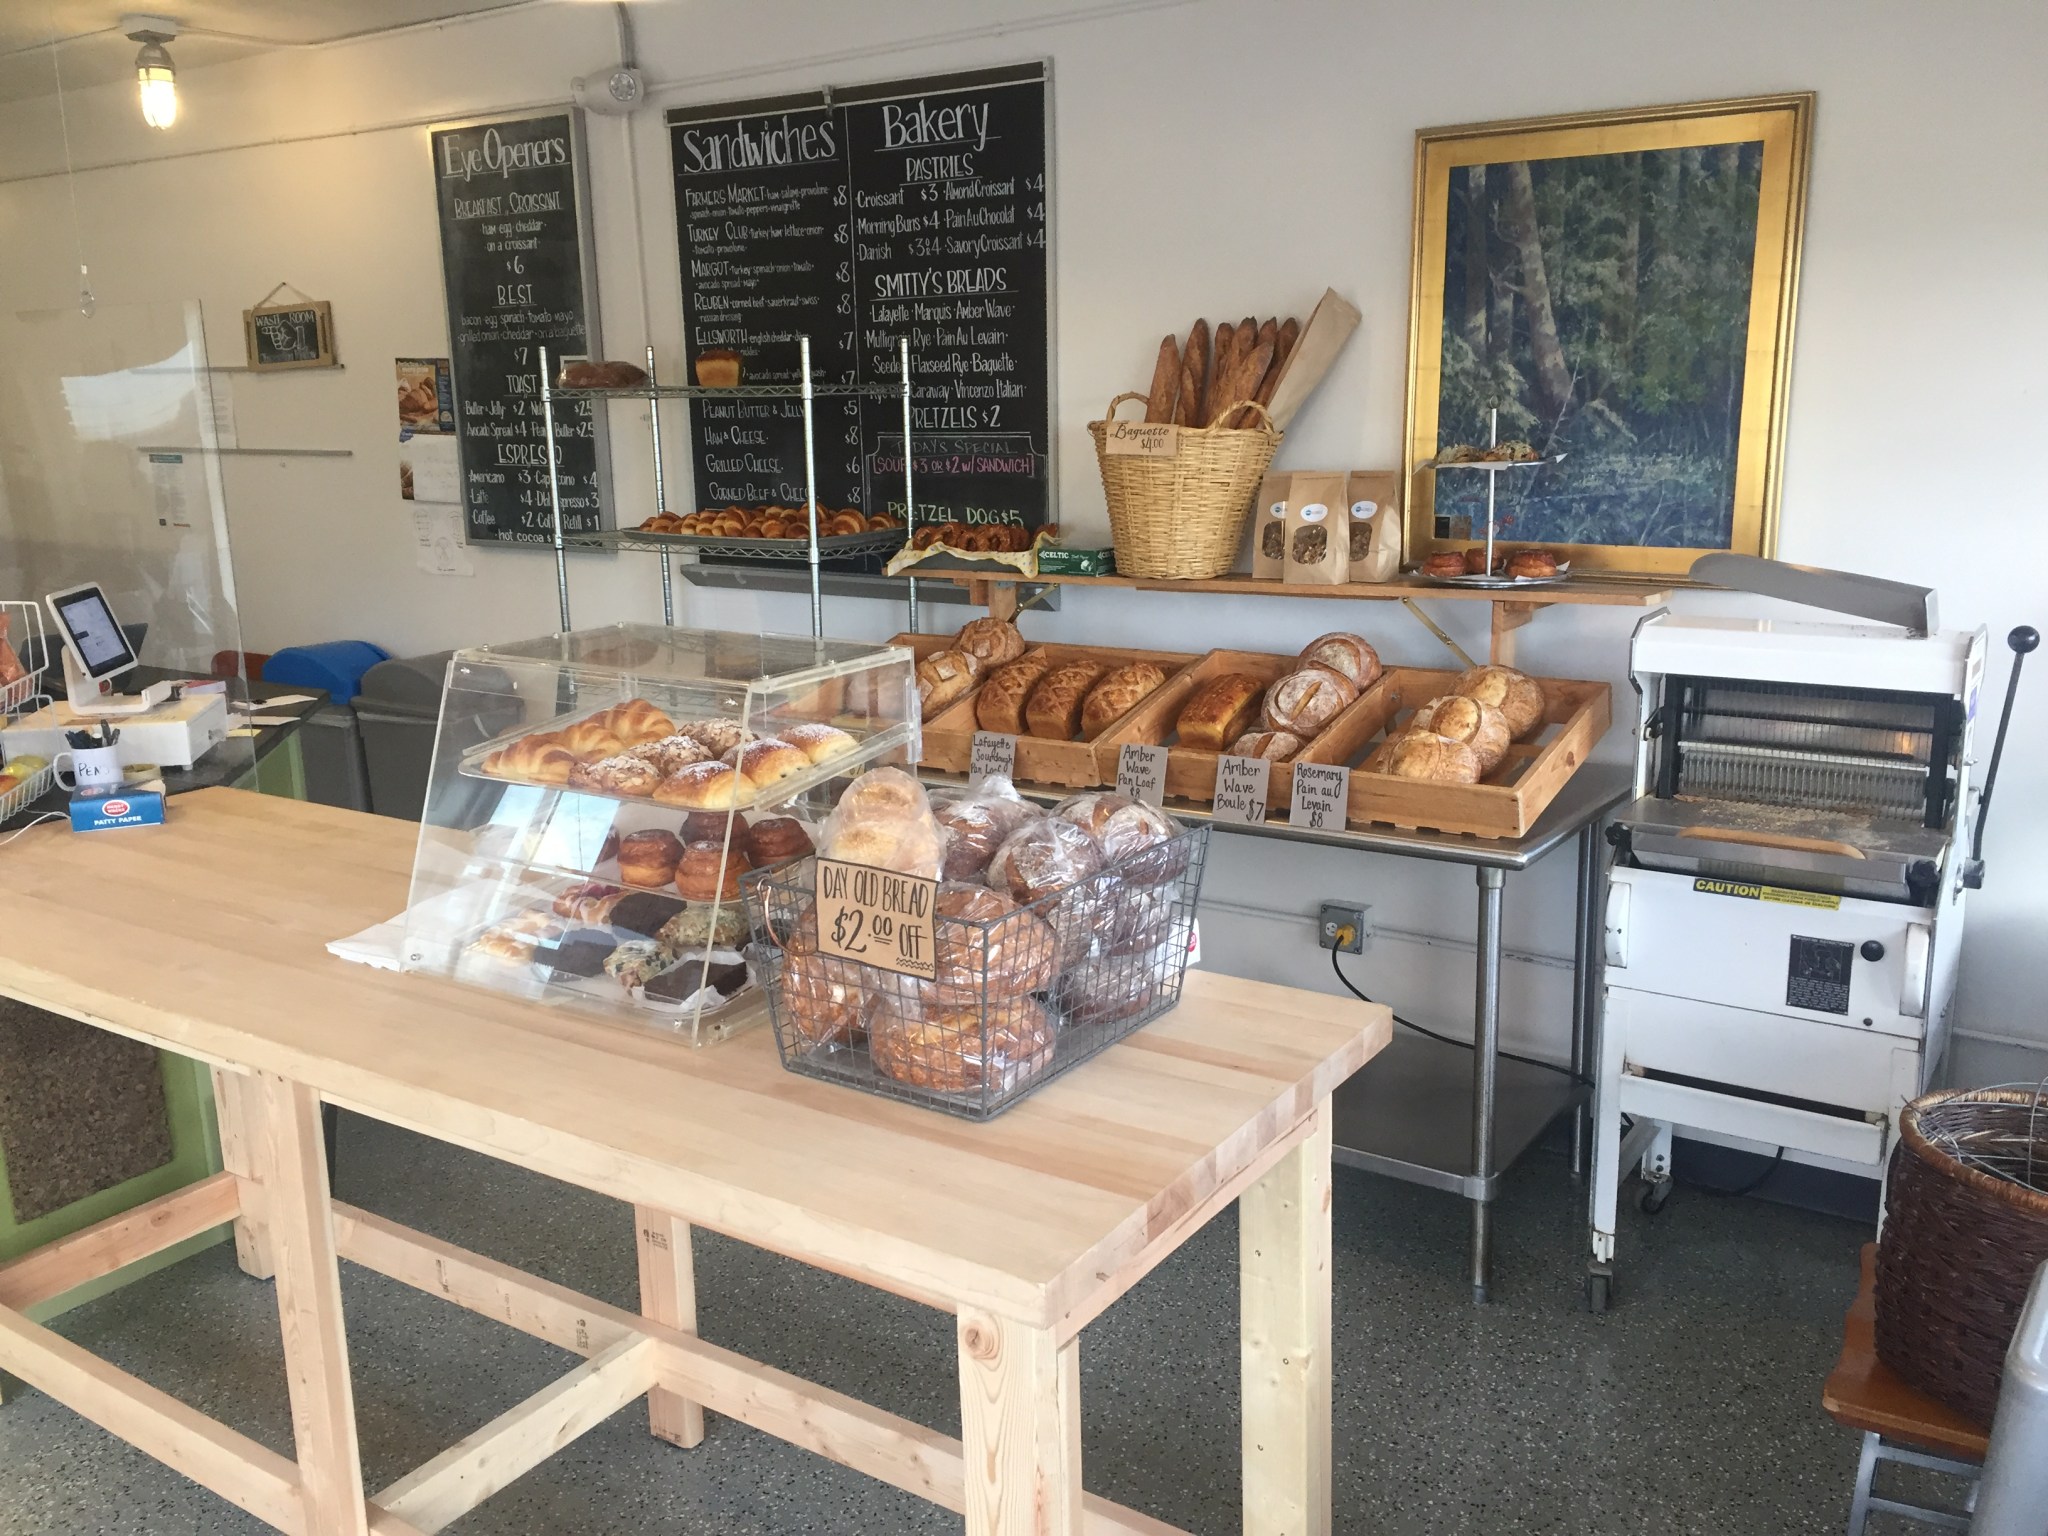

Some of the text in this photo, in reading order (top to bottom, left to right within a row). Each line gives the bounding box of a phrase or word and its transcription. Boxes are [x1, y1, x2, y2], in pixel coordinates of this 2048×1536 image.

[882, 99, 989, 152] Bakery
[683, 114, 836, 173] Sandwiches
[442, 128, 566, 182] Eye Openers
[905, 152, 974, 181] PASTRIES
[685, 187, 726, 207] FARMERS
[727, 182, 765, 203] MARKET
[974, 176, 1015, 198] Croissant
[454, 191, 560, 219] BREAKFAST CROISSANT
[857, 188, 904, 208] Croissant
[979, 204, 1015, 225] Chocolat
[687, 223, 719, 243] TURKEY
[725, 221, 749, 240] CLUB
[858, 216, 896, 238] Morning
[896, 214, 921, 233] Buns
[858, 241, 892, 262] Danish
[980, 231, 1023, 254] Croissant
[691, 259, 729, 278] MARGOT
[874, 267, 1007, 298] SMITTY'S BREADS
[694, 292, 729, 311] REUBEN
[871, 298, 1012, 326] Lafayette Marquis Amber Wave
[695, 327, 749, 346] ELLSWORTH
[912, 325, 1005, 352] Rye Pain Au Levain
[873, 352, 1014, 377] Seede Flaxseed Rye Baguette
[506, 374, 538, 394] TOAST
[953, 379, 995, 399] Vincenzo
[996, 378, 1024, 399] Italian
[703, 399, 735, 419] PEANUT
[736, 399, 770, 418] BUTTER
[704, 426, 723, 446] HAM
[1112, 422, 1170, 440] Baguette
[498, 443, 562, 465] ESPRESO
[890, 439, 1018, 455] TDAY'S SPECIAL
[1141, 437, 1164, 452] $4.00
[705, 453, 744, 473] GRILLED
[931, 460, 943, 471] OR
[780, 482, 815, 502] CHEE
[472, 509, 496, 526] Coffee
[966, 506, 999, 525] DOG
[498, 527, 545, 543] hot cocoa
[1044, 551, 1069, 559] CELTIC
[973, 734, 1011, 751] Lafayette
[1123, 744, 1156, 762] Amber
[78, 762, 107, 777] PEN
[1126, 761, 1151, 775] Wave
[1222, 758, 1261, 776] Amber
[1118, 772, 1156, 790] Pan Loaf
[1224, 778, 1255, 794] Wave
[1296, 762, 1343, 794] Rosemary
[1296, 778, 1334, 796] Pain au
[1216, 793, 1264, 822] Boule $7
[1301, 796, 1333, 813] Levain
[94, 815, 142, 826] PATTY PAPER
[1309, 811, 1323, 828] $8
[823, 865, 929, 919] DAY OLD BREAD
[1695, 879, 1761, 898] CAUTION
[830, 905, 928, 960] $2.00 OFF
